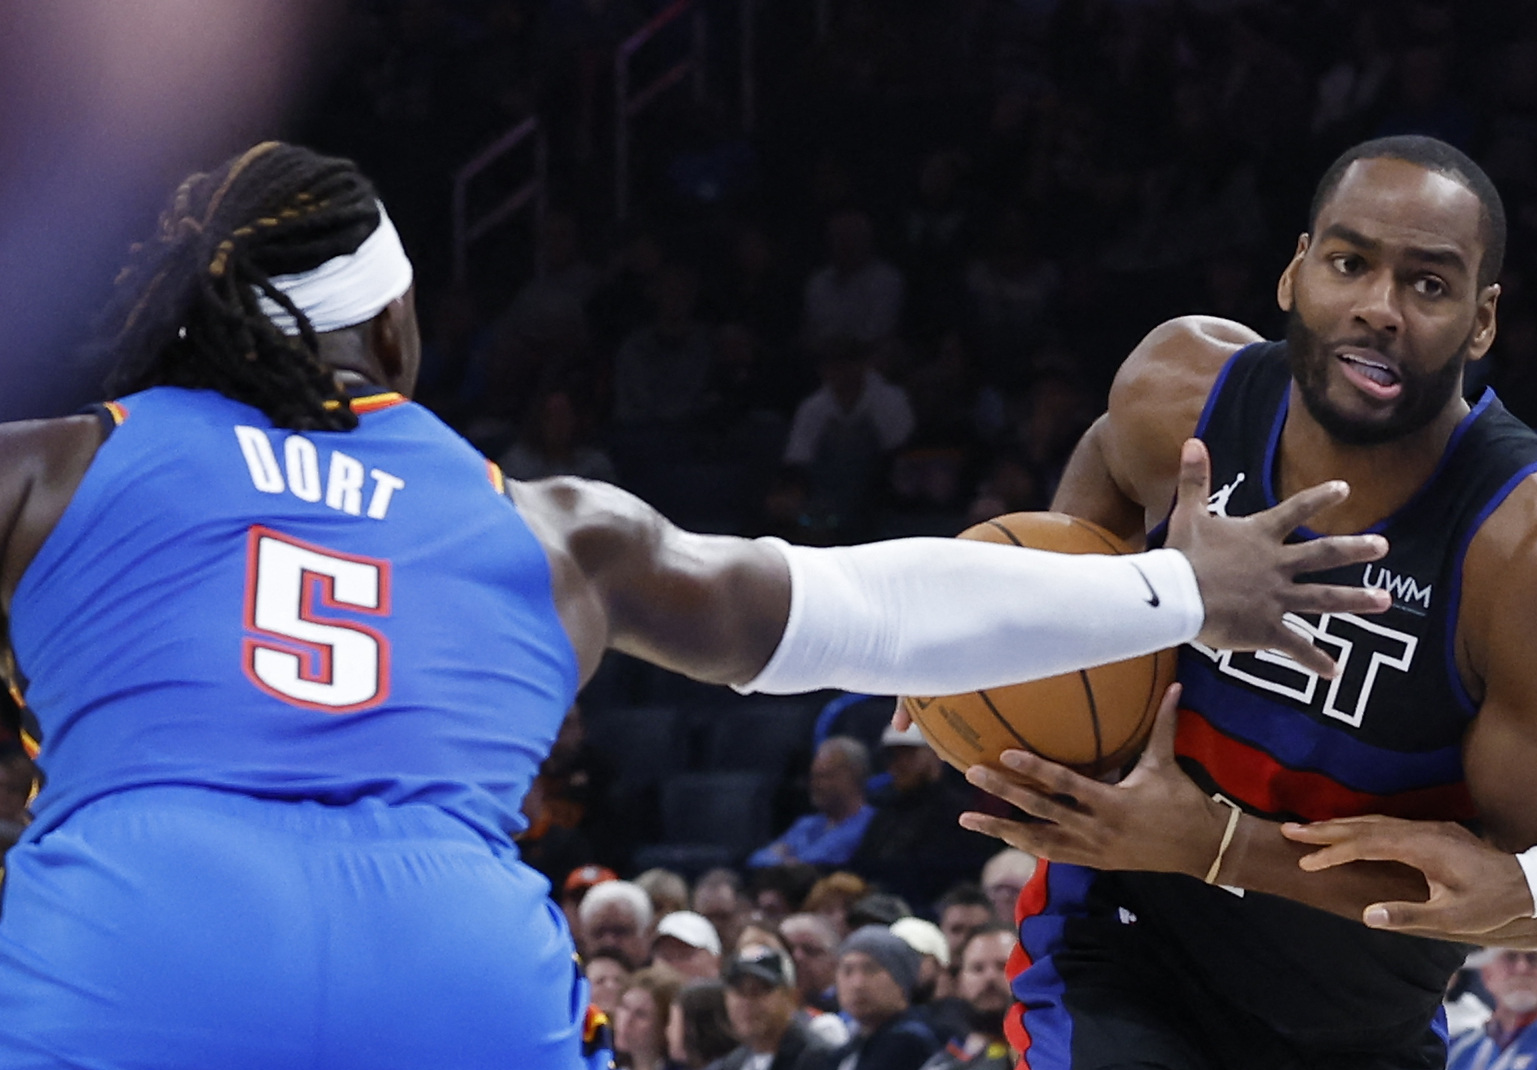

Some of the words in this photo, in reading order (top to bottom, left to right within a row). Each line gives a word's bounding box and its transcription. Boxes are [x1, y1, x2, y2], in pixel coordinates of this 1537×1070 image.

[234, 424, 405, 520] DORT
[242, 523, 392, 713] 5
[1362, 563, 1432, 609] UWM
[1187, 611, 1418, 728] ET
